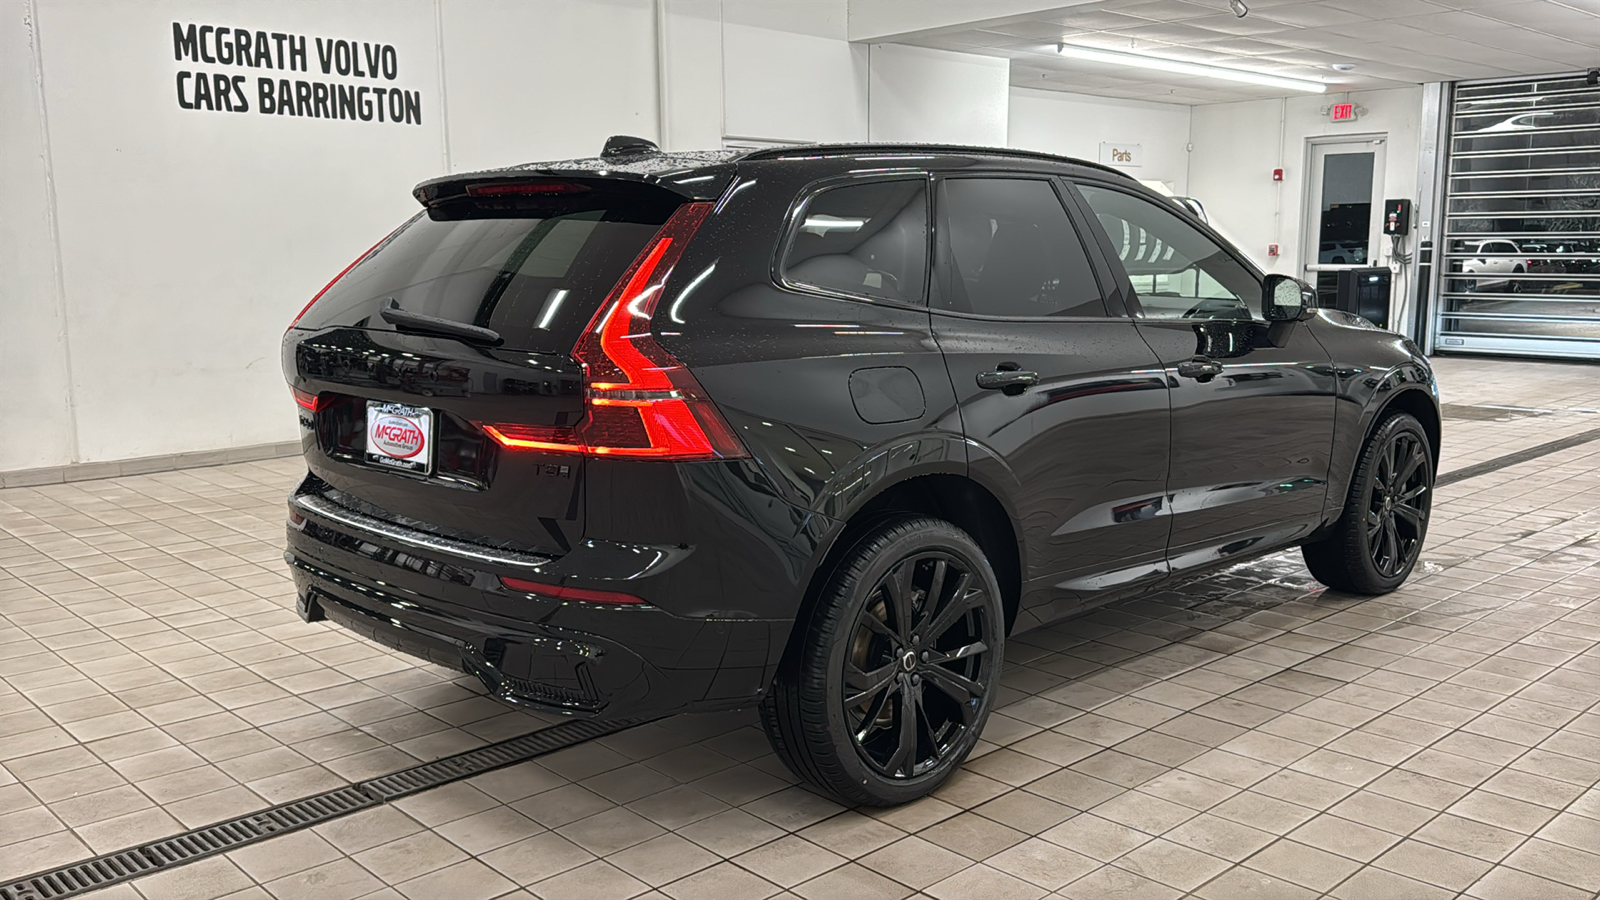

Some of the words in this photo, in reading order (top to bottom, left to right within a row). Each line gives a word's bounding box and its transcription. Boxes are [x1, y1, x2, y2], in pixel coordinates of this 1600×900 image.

[172, 22, 307, 72] MCGRATH
[315, 37, 398, 80] VOLVO
[176, 70, 249, 113] CARS
[257, 77, 422, 125] BARRINGTON
[1333, 103, 1353, 120] EXIT
[1112, 148, 1132, 162] Parts
